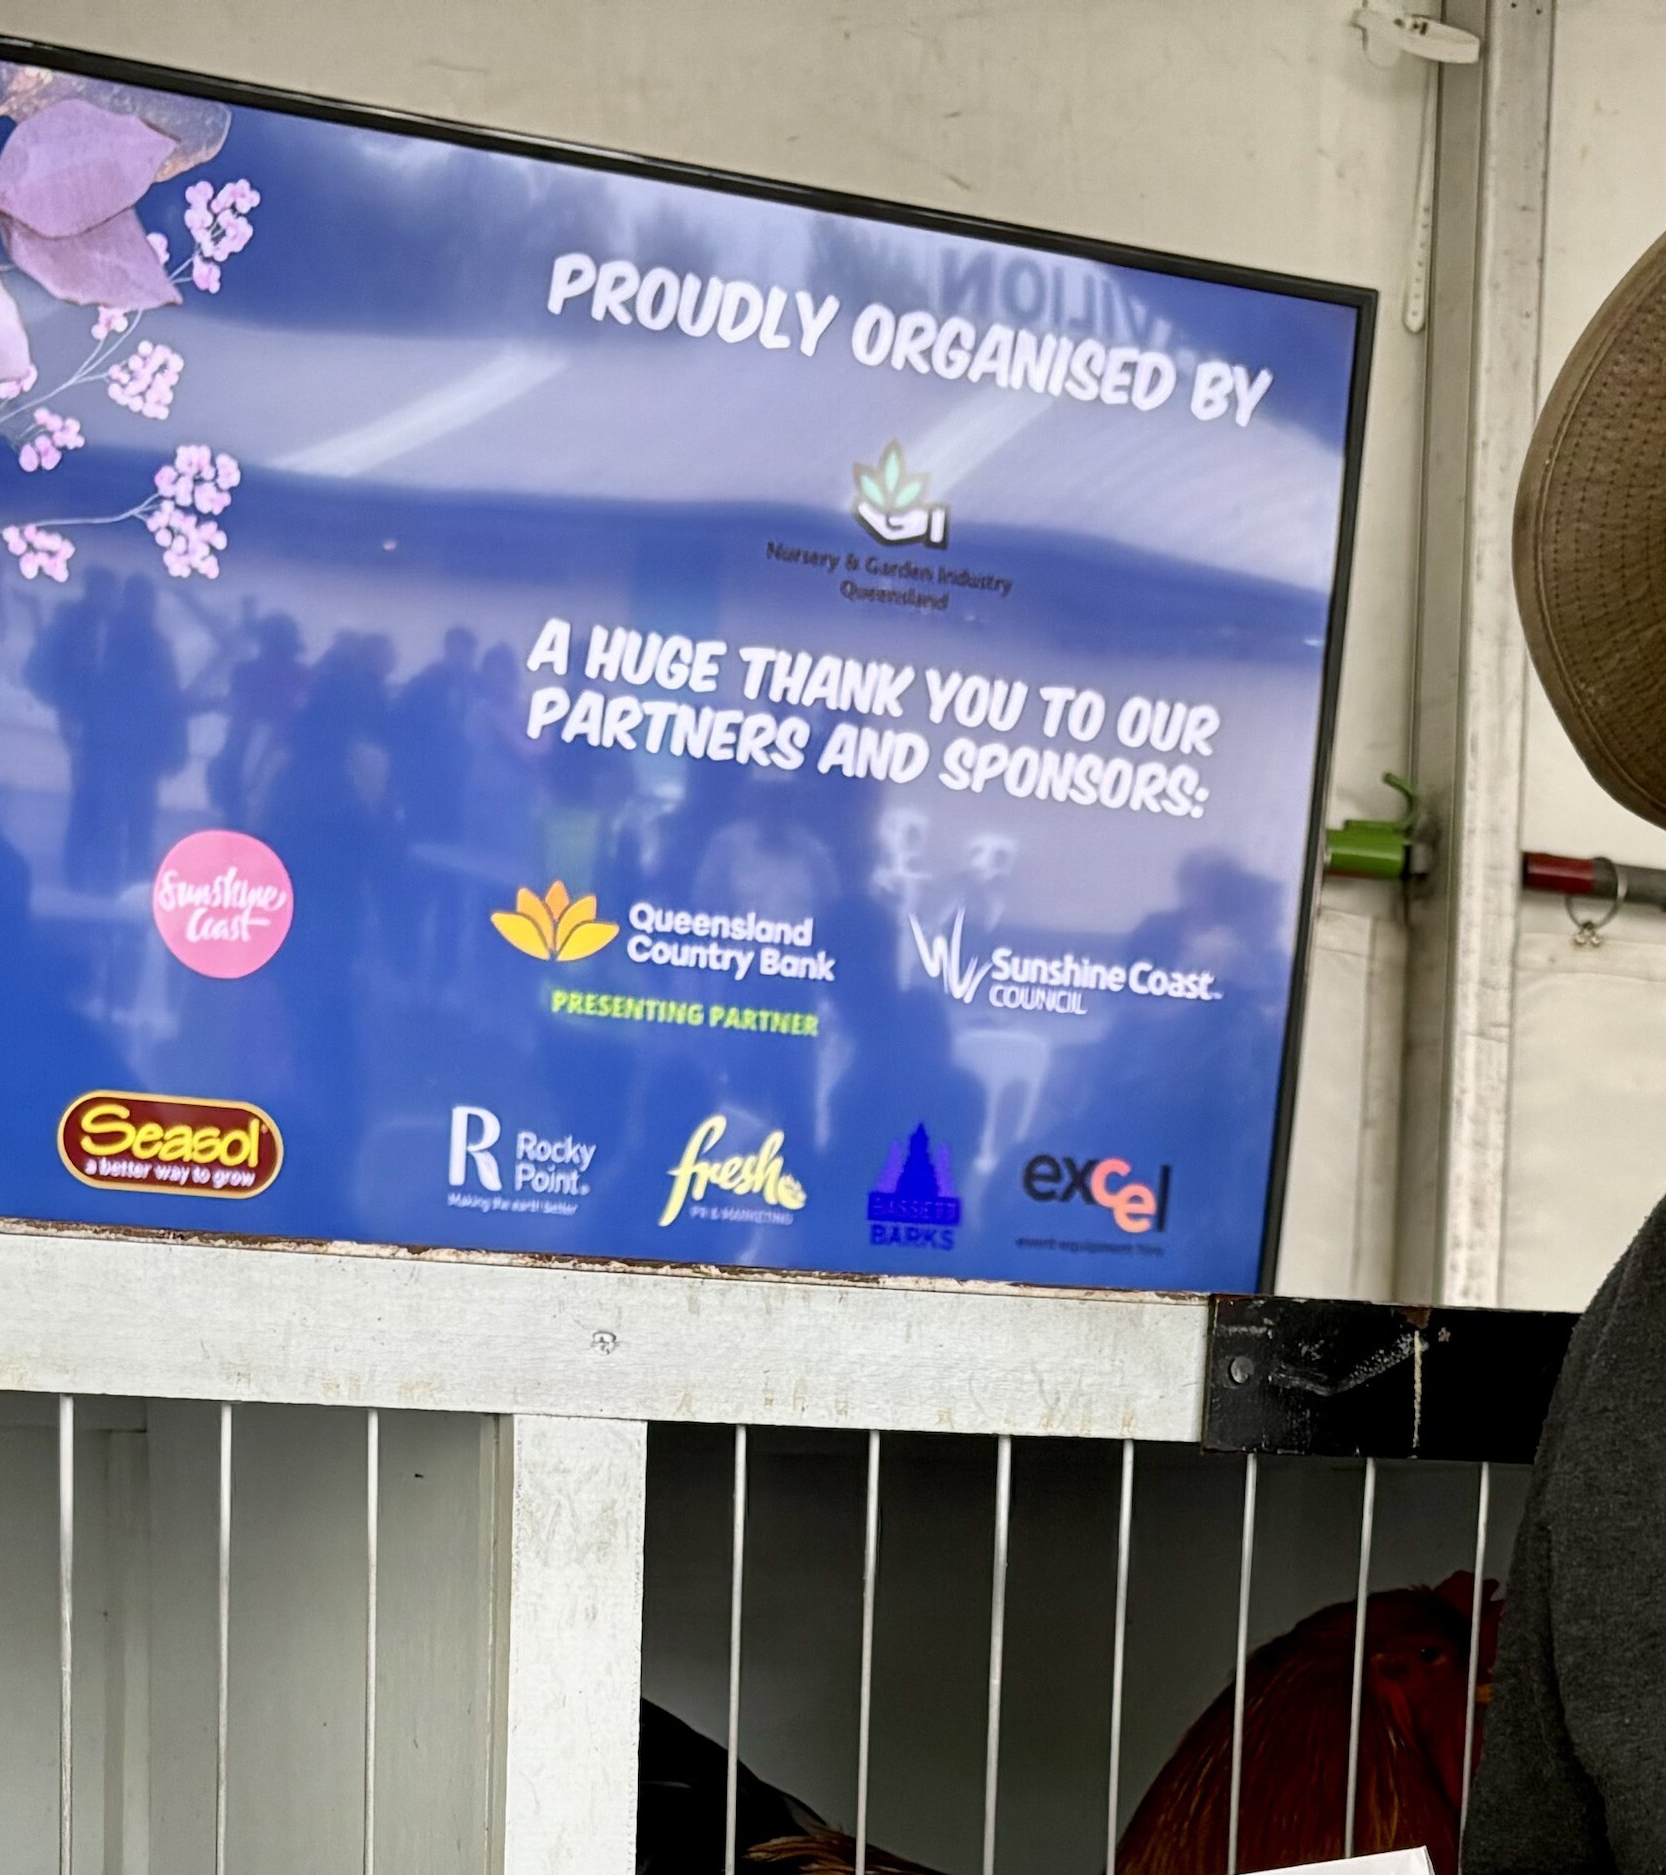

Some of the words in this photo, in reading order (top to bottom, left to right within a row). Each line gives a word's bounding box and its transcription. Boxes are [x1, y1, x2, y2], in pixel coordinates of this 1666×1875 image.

[546, 253, 839, 356] PROUDLY
[852, 304, 1177, 411] ORGANISED
[1191, 361, 1274, 427] BY
[766, 541, 840, 573] Nursery
[845, 553, 859, 571] &
[865, 556, 933, 582] Garden
[938, 566, 1013, 597] Industry
[840, 580, 949, 610] Queensland
[526, 618, 572, 674] A
[584, 624, 727, 693] HUGE
[738, 646, 916, 718] THANK
[925, 667, 1028, 732] YOU
[1039, 685, 1105, 741] TO
[1116, 697, 1220, 757] OUR
[525, 687, 811, 770] PARTNERS
[816, 723, 930, 785] AND
[938, 736, 1210, 819] SPONSORS:
[159, 866, 287, 912] Sunshine
[186, 907, 271, 943] Coast
[629, 901, 814, 947] Queensland
[627, 934, 756, 981] Country
[759, 946, 836, 981] Bank
[990, 947, 1126, 992] Sunshine
[1129, 960, 1215, 1001] Coast
[551, 988, 704, 1027] PRESENTING
[709, 1004, 819, 1037] PARTNER
[988, 984, 1087, 1015] COUNCIL
[80, 1103, 259, 1168] Seasol
[516, 1130, 597, 1171] Rocky
[84, 1158, 97, 1175] a
[99, 1157, 152, 1179] better
[154, 1164, 190, 1185] way
[192, 1166, 211, 1184] to
[212, 1170, 256, 1189] grow
[658, 1115, 787, 1227] fresh
[1023, 1153, 1172, 1233] excel
[869, 1223, 955, 1251] BARKS
